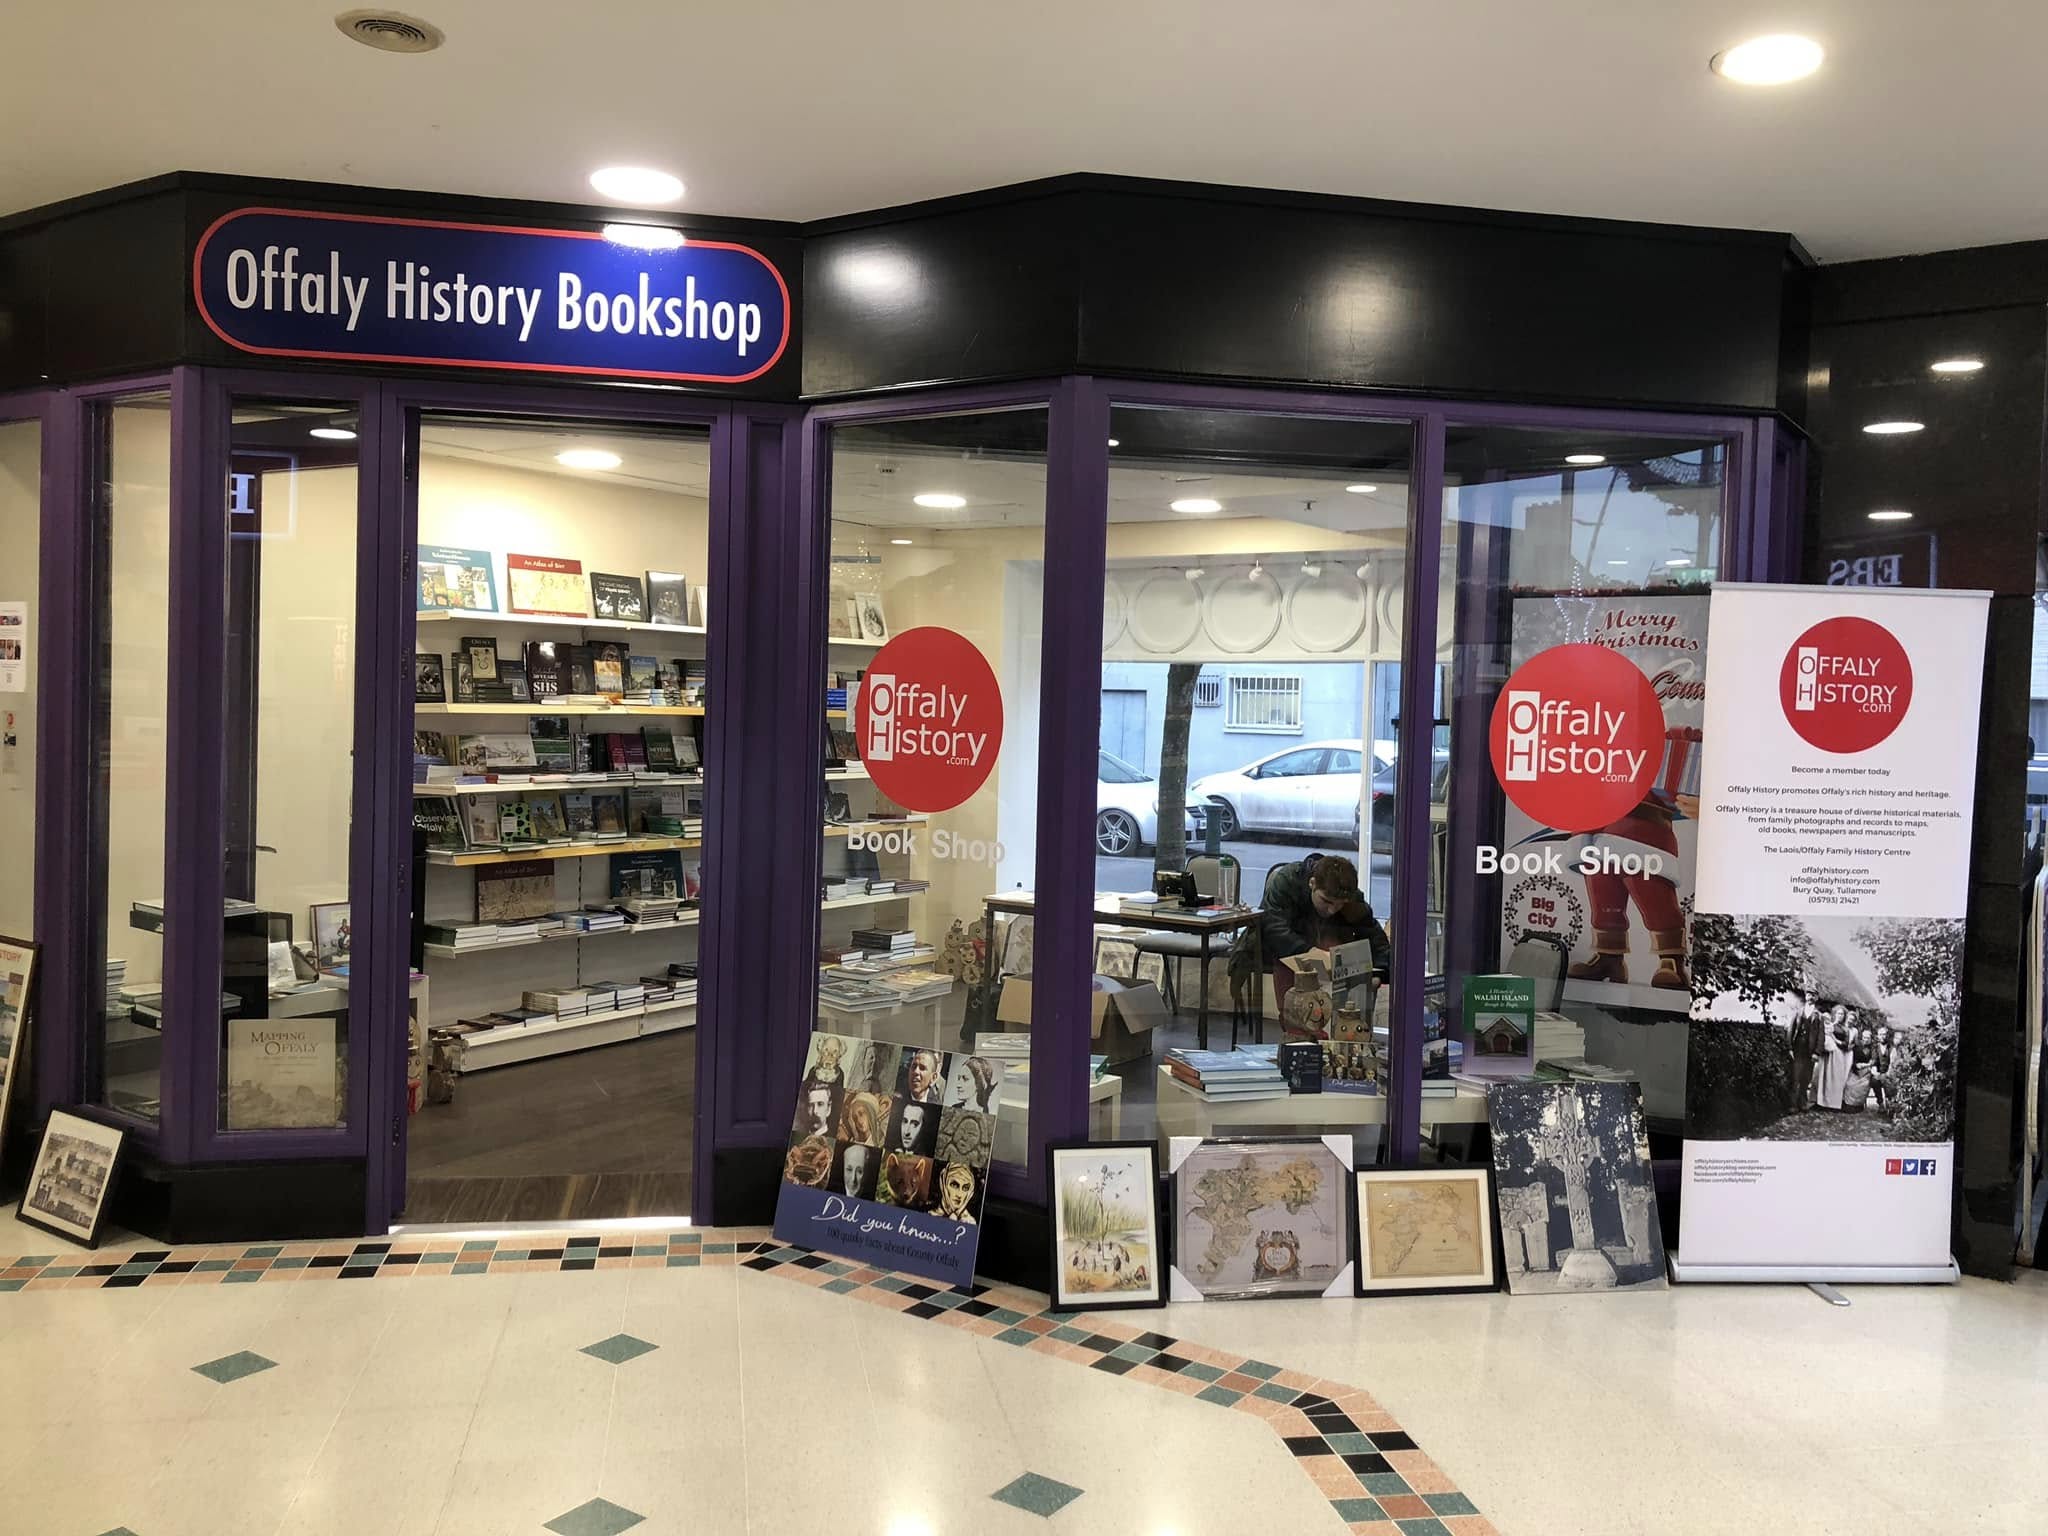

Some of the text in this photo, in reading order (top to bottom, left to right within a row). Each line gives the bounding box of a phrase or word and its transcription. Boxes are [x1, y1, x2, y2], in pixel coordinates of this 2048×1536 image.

[226, 246, 761, 357] Offaly History Bookshop
[1595, 610, 1676, 632] Merry
[1799, 656, 1881, 677] OFFALY
[533, 682, 558, 692] SHS
[1799, 683, 1897, 705] HISTORY
[870, 682, 968, 727] Offaly
[1858, 700, 1891, 713] .com
[1509, 700, 1625, 744] Offaly
[870, 720, 987, 766] History
[946, 756, 970, 766] .com
[1509, 738, 1647, 783] History
[1791, 766, 1824, 774] Become
[1832, 767, 1866, 775] member
[1868, 768, 1891, 776] today
[1600, 773, 1628, 783] .com
[1727, 785, 1751, 795] Offaly
[1752, 786, 1780, 795] History
[1781, 787, 1819, 796] promotes
[1821, 788, 1850, 797] Offaly's
[1851, 788, 1867, 796] rich
[1868, 789, 1896, 798] history
[1897, 790, 1913, 798] and
[1715, 805, 1740, 814] Offaly
[1742, 806, 1769, 815] History
[1770, 806, 1777, 814] is
[1785, 807, 1818, 815] treasure
[1819, 807, 1842, 816] house
[1844, 808, 1853, 816] of
[1854, 808, 1882, 816] diverse
[1883, 809, 1921, 818] historical
[1768, 816, 1792, 825] family
[1793, 817, 1845, 826] photographs
[1846, 818, 1862, 826] and
[1863, 818, 1893, 827] records
[1758, 826, 1771, 834] old
[1799, 828, 1847, 837] newspapers
[1848, 828, 1863, 836] and
[847, 826, 1006, 868] Book Shop
[1763, 845, 1911, 857] The Laois/Offaly Family History Centre
[1475, 845, 1664, 880] Book Shop
[1801, 866, 1870, 876] offalyhistory.com
[1790, 876, 1880, 886] info@offalyhistory.com
[1792, 886, 1811, 895] Bury
[1837, 887, 1877, 896] Tullamore
[1531, 896, 1555, 912] Big
[1808, 896, 1859, 905] (05793) 21421
[1528, 912, 1558, 928] City
[1474, 994, 1529, 1002] WALSH ISLAND
[251, 1031, 305, 1043] MAPPING
[264, 1041, 320, 1056] OFFALY
[811, 1196, 860, 1224] Did
[860, 1216, 893, 1233] you
